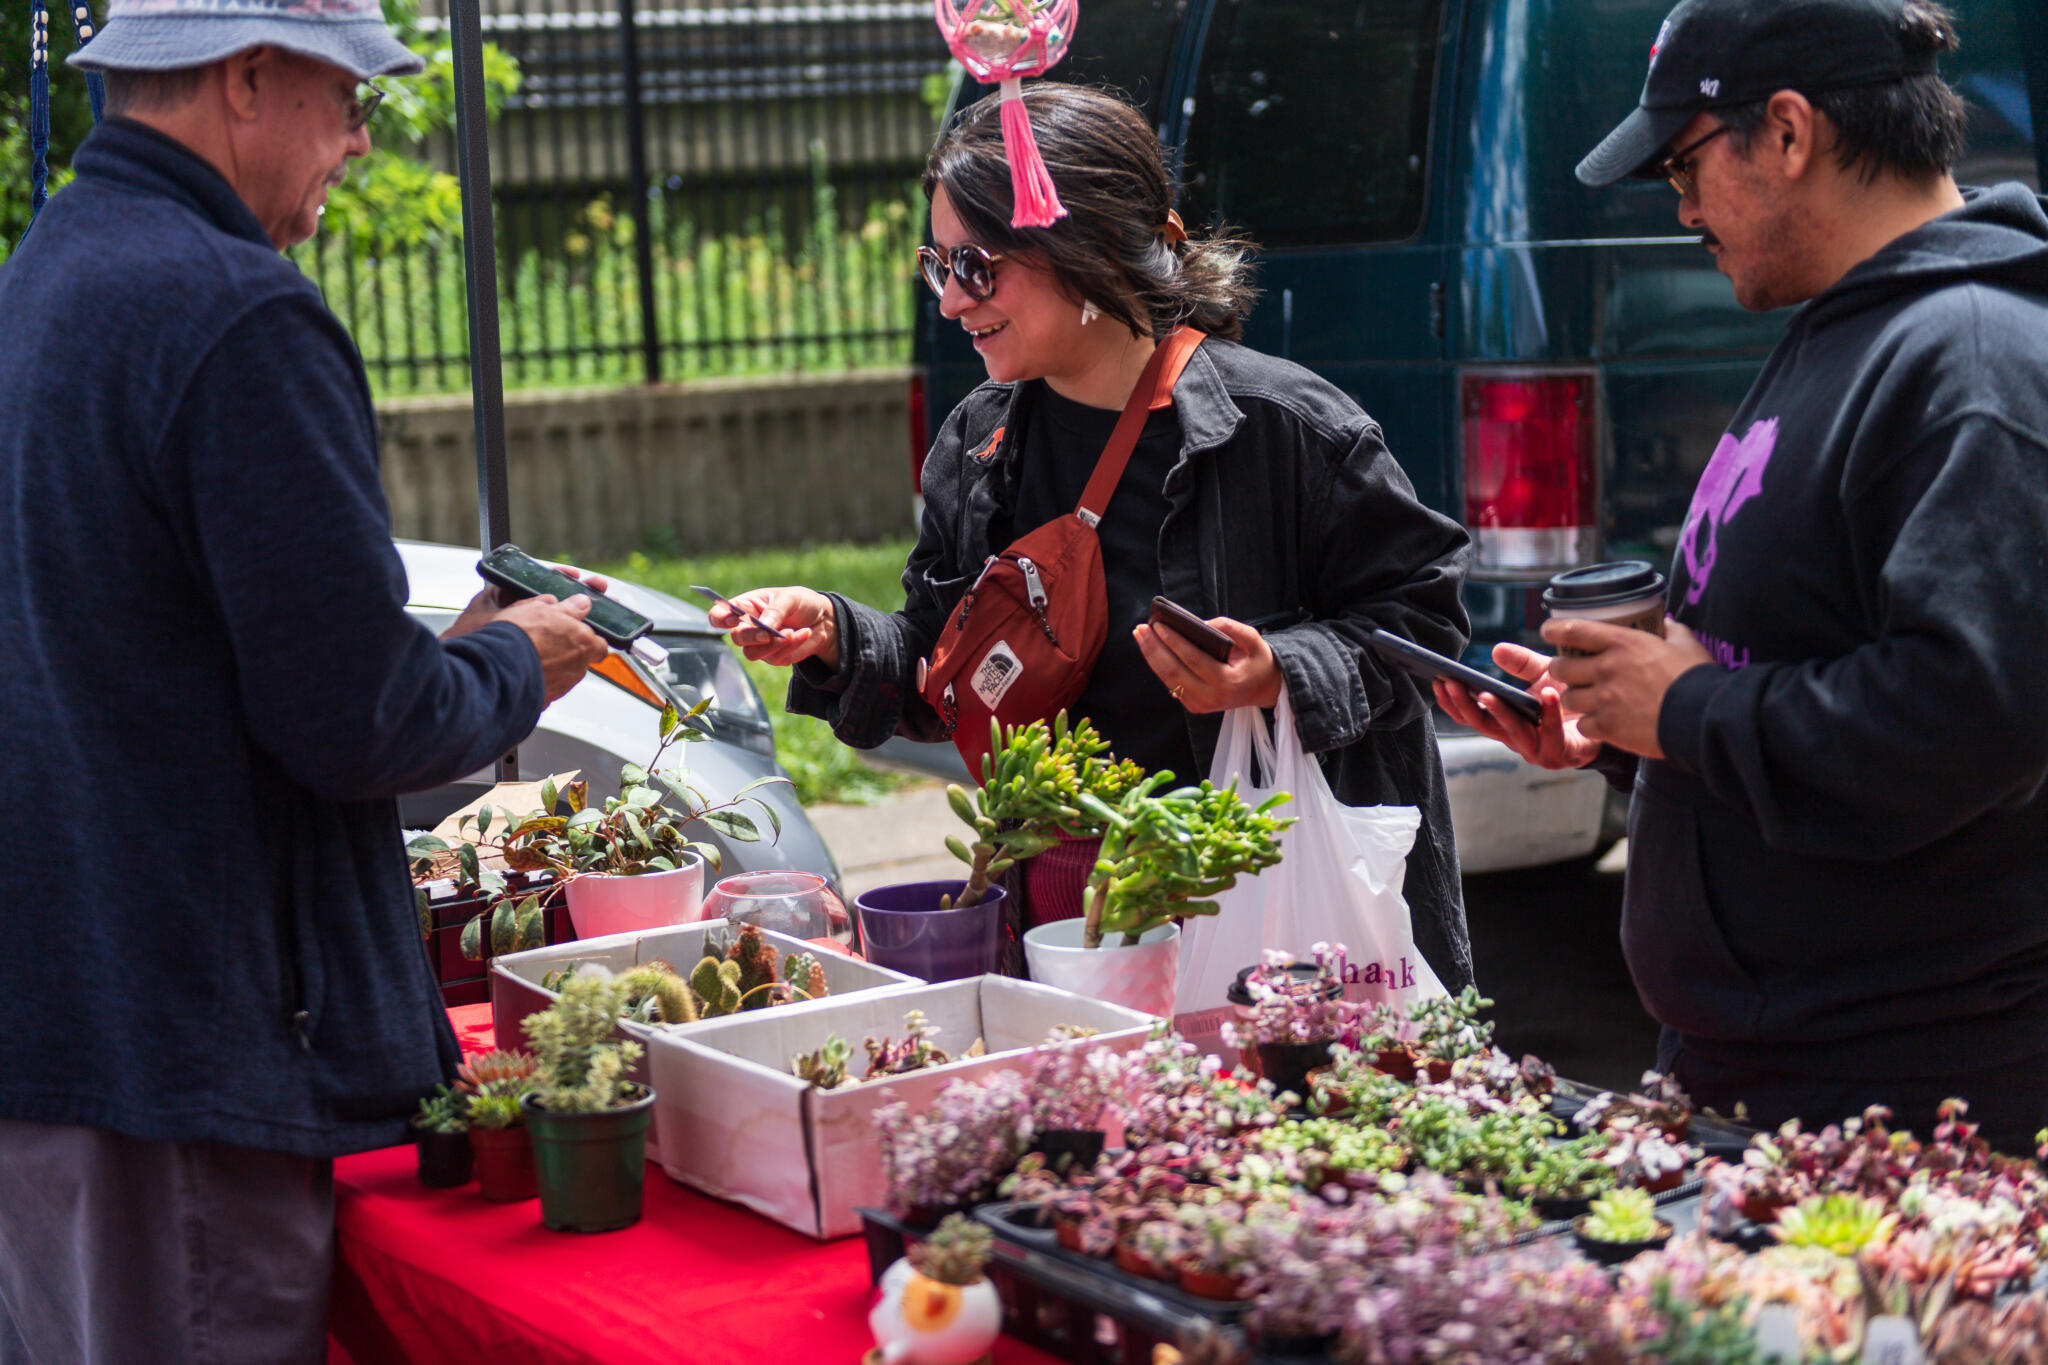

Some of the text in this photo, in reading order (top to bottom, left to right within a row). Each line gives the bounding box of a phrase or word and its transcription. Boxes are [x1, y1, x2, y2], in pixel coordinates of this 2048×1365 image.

[980, 660, 992, 676] THE
[978, 666, 999, 694] NORTH
[987, 672, 1004, 694] FACE
